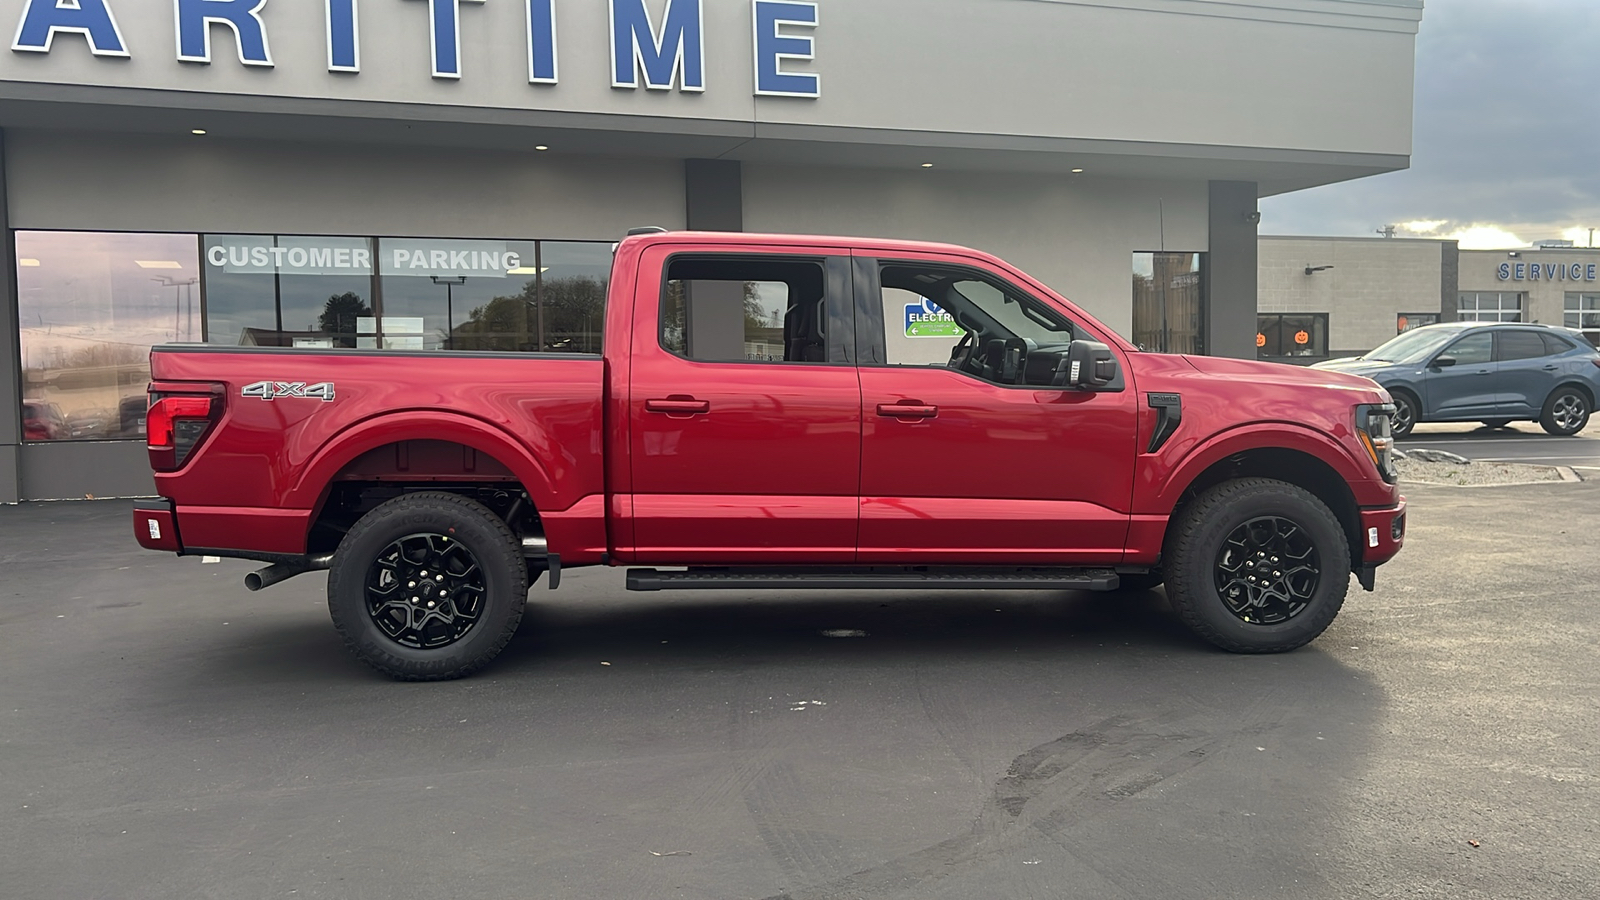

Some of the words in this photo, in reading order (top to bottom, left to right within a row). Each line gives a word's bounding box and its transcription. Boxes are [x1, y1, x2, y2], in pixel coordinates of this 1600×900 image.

[208, 245, 371, 268] CUSTOMER
[394, 249, 520, 270] PARKING
[1498, 262, 1596, 280] SERVICE
